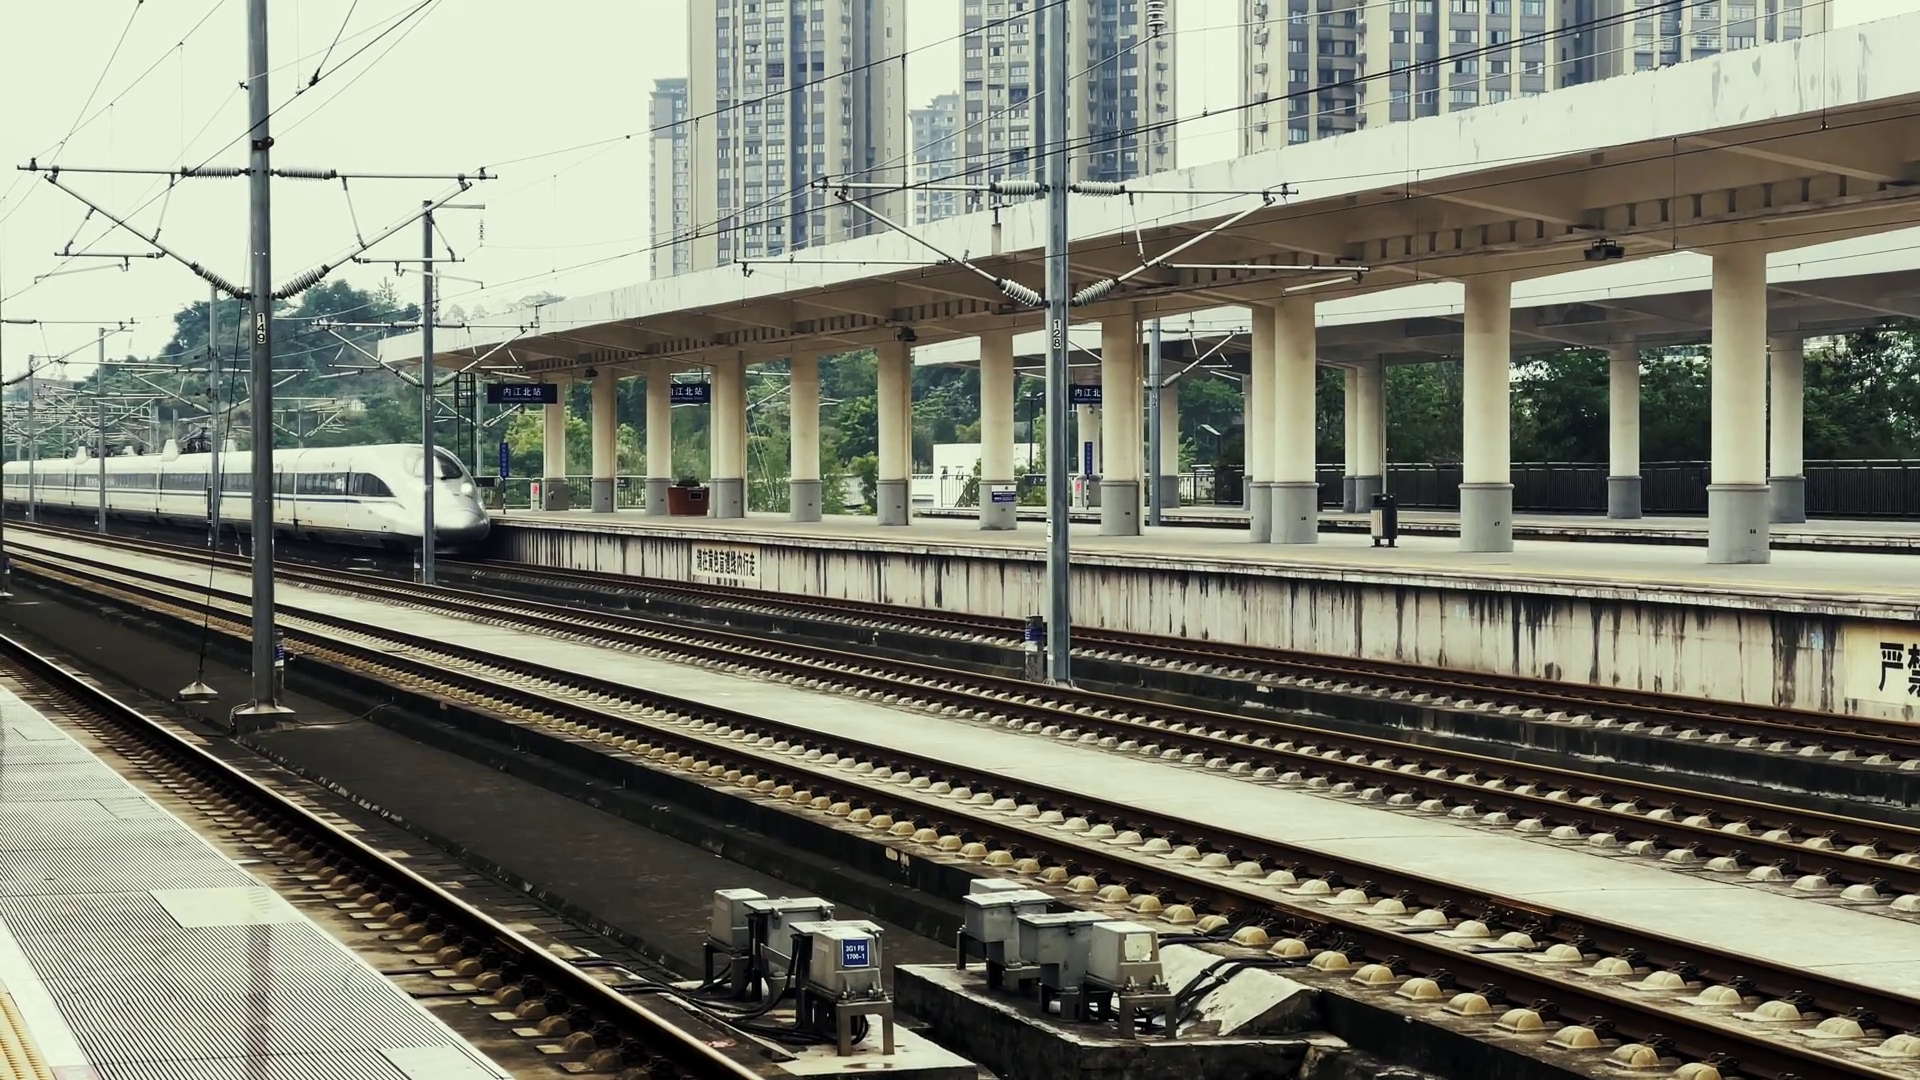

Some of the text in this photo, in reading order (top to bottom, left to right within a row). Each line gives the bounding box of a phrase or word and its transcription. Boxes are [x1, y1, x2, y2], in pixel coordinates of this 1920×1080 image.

[257, 313, 266, 343] 149
[1053, 320, 1061, 348] 128
[503, 387, 541, 397] 内江北站
